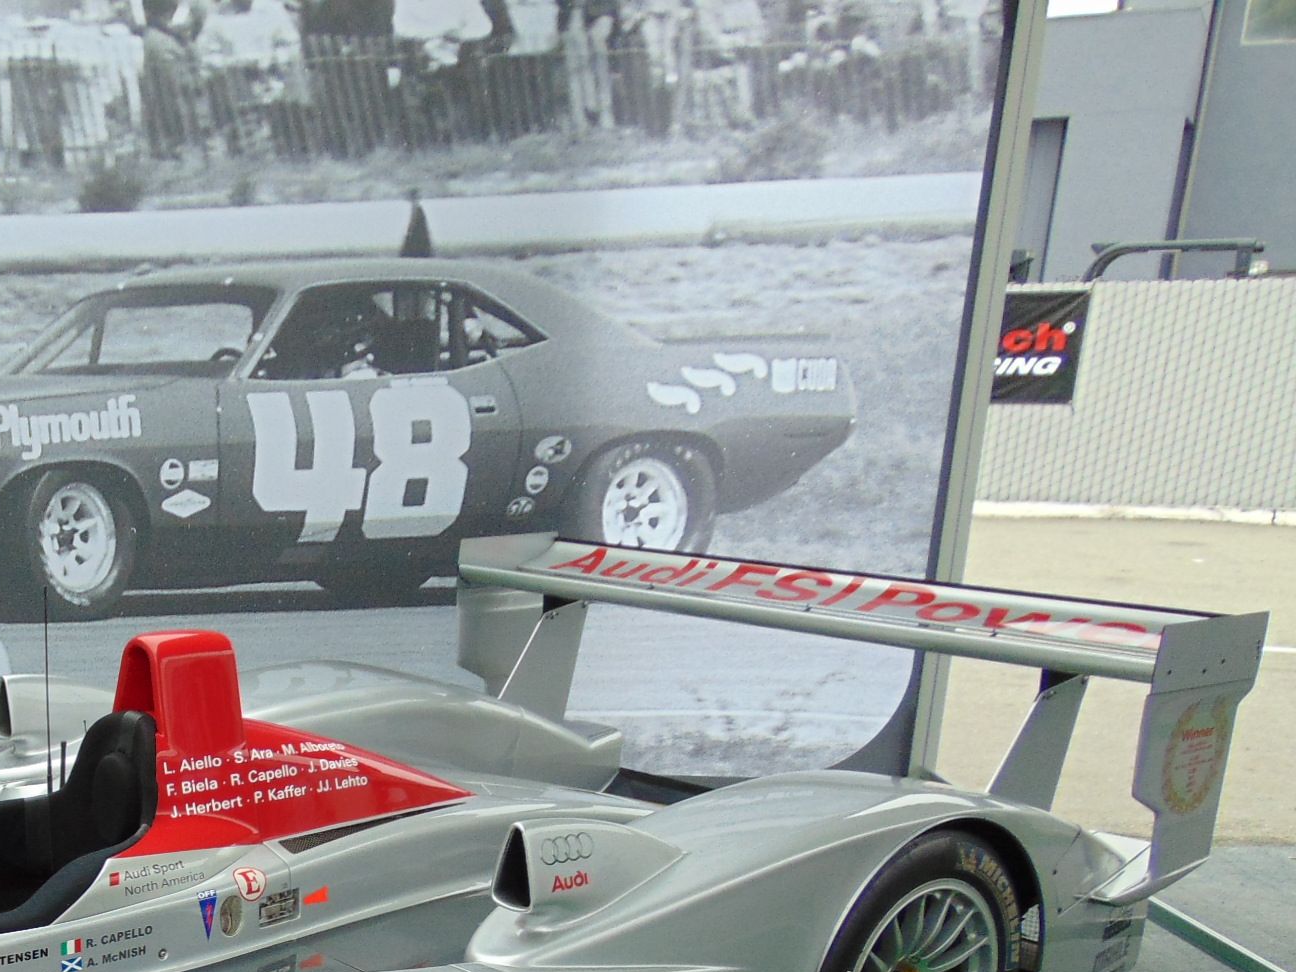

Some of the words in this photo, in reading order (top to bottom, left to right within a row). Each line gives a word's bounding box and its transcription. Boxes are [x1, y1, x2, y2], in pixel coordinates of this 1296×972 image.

[1002, 321, 1068, 353] ch
[247, 386, 472, 543] 48
[548, 546, 719, 587] Audi
[707, 563, 865, 606] FSI
[163, 762, 176, 775] L.
[180, 755, 222, 773] Aiello
[234, 752, 248, 764] S.
[251, 747, 274, 761] Ara
[281, 743, 298, 756] M.
[166, 783, 177, 797] F.
[182, 777, 219, 795] Biela
[230, 774, 244, 786] R.
[248, 764, 298, 784] Capello
[308, 761, 317, 773] J.
[319, 756, 358, 771] Davies
[170, 805, 182, 819] J.
[186, 795, 243, 816] Herbert
[254, 791, 265, 804] P.
[268, 784, 307, 801] Kaffer
[335, 774, 368, 790] Lehto
[124, 866, 151, 881] Audi
[152, 860, 184, 875] Sport
[124, 881, 159, 896] North
[161, 871, 205, 888] America
[552, 870, 589, 893] Audi
[197, 889, 216, 899] OFF
[86, 937, 98, 949] R.
[100, 925, 153, 945] CAPELLO
[86, 957, 98, 968] A.
[102, 945, 146, 964] McNISH
